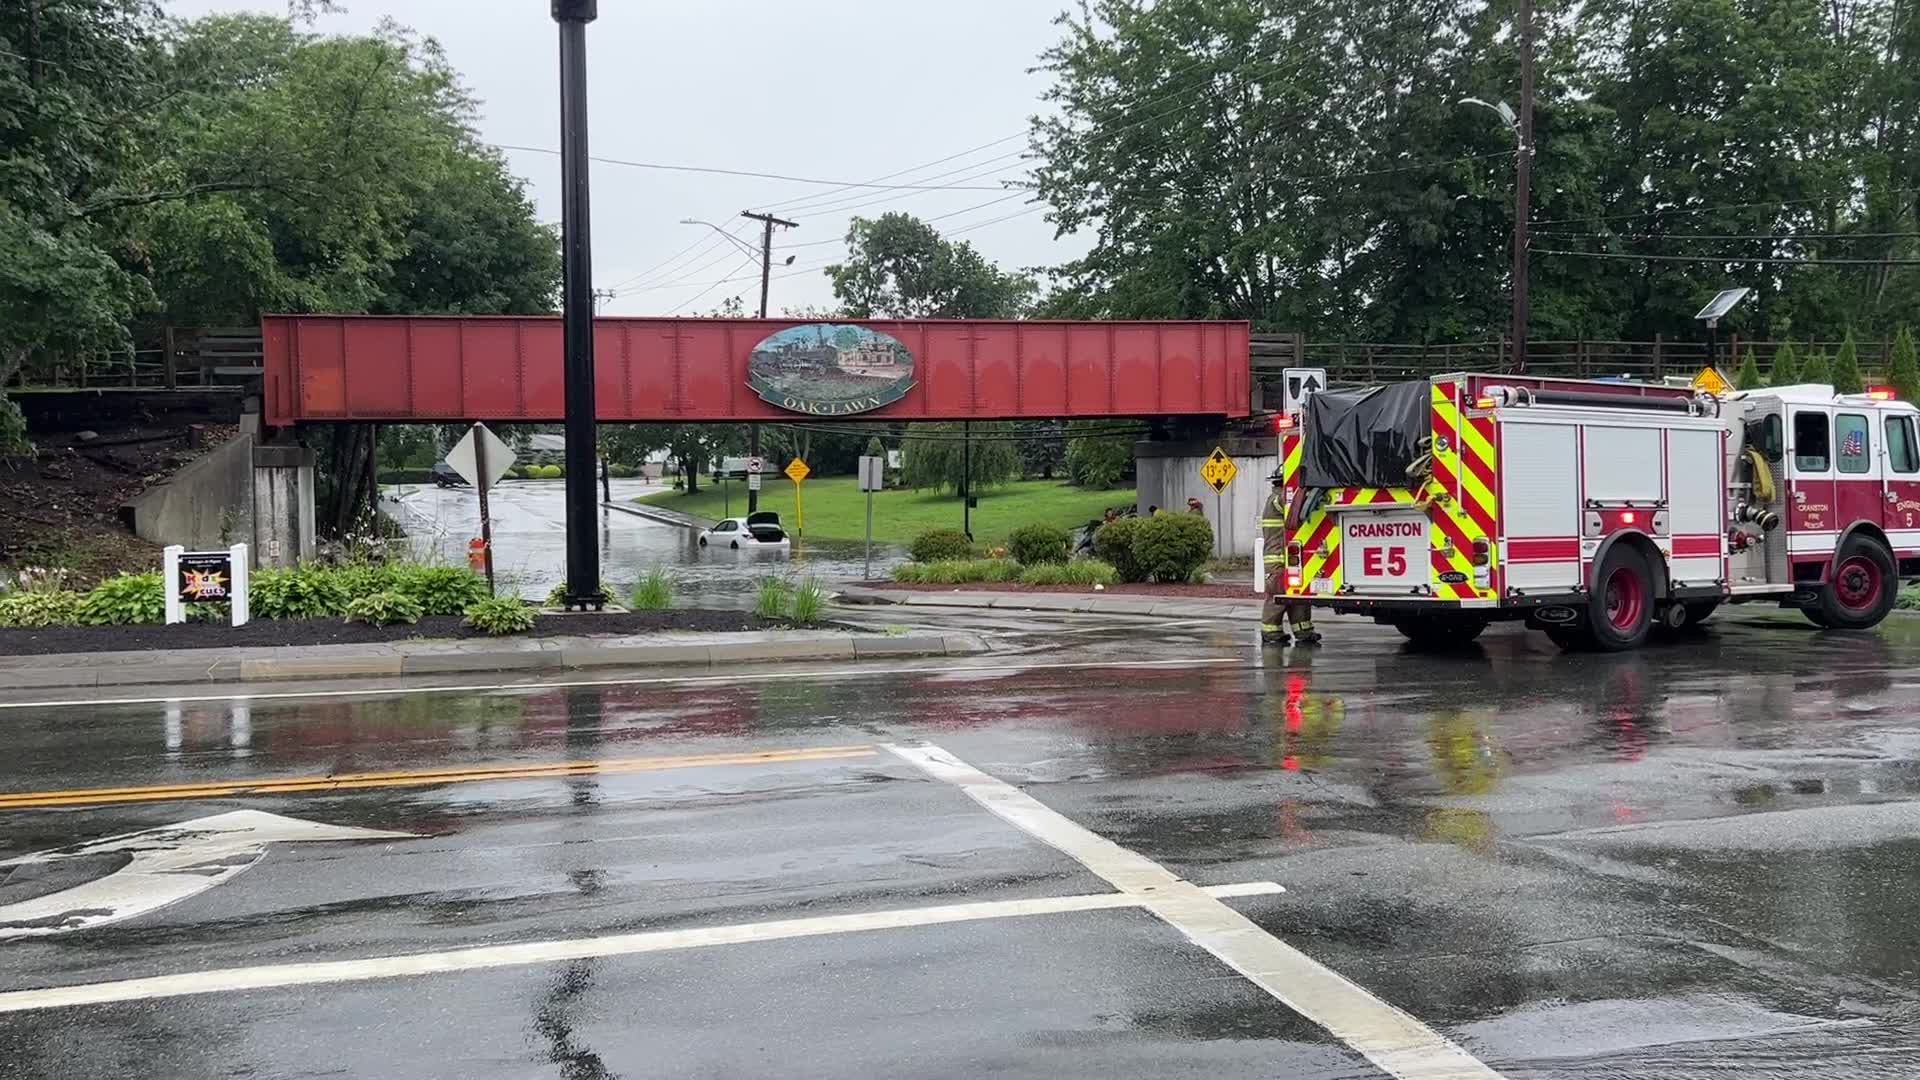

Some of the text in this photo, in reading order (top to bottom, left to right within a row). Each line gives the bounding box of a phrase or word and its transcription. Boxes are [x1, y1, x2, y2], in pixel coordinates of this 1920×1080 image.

[784, 395, 880, 413] OAK LAWN
[1906, 512, 1913, 527] 5
[1349, 522, 1422, 538] CRANSTON
[1363, 547, 1407, 576] E5
